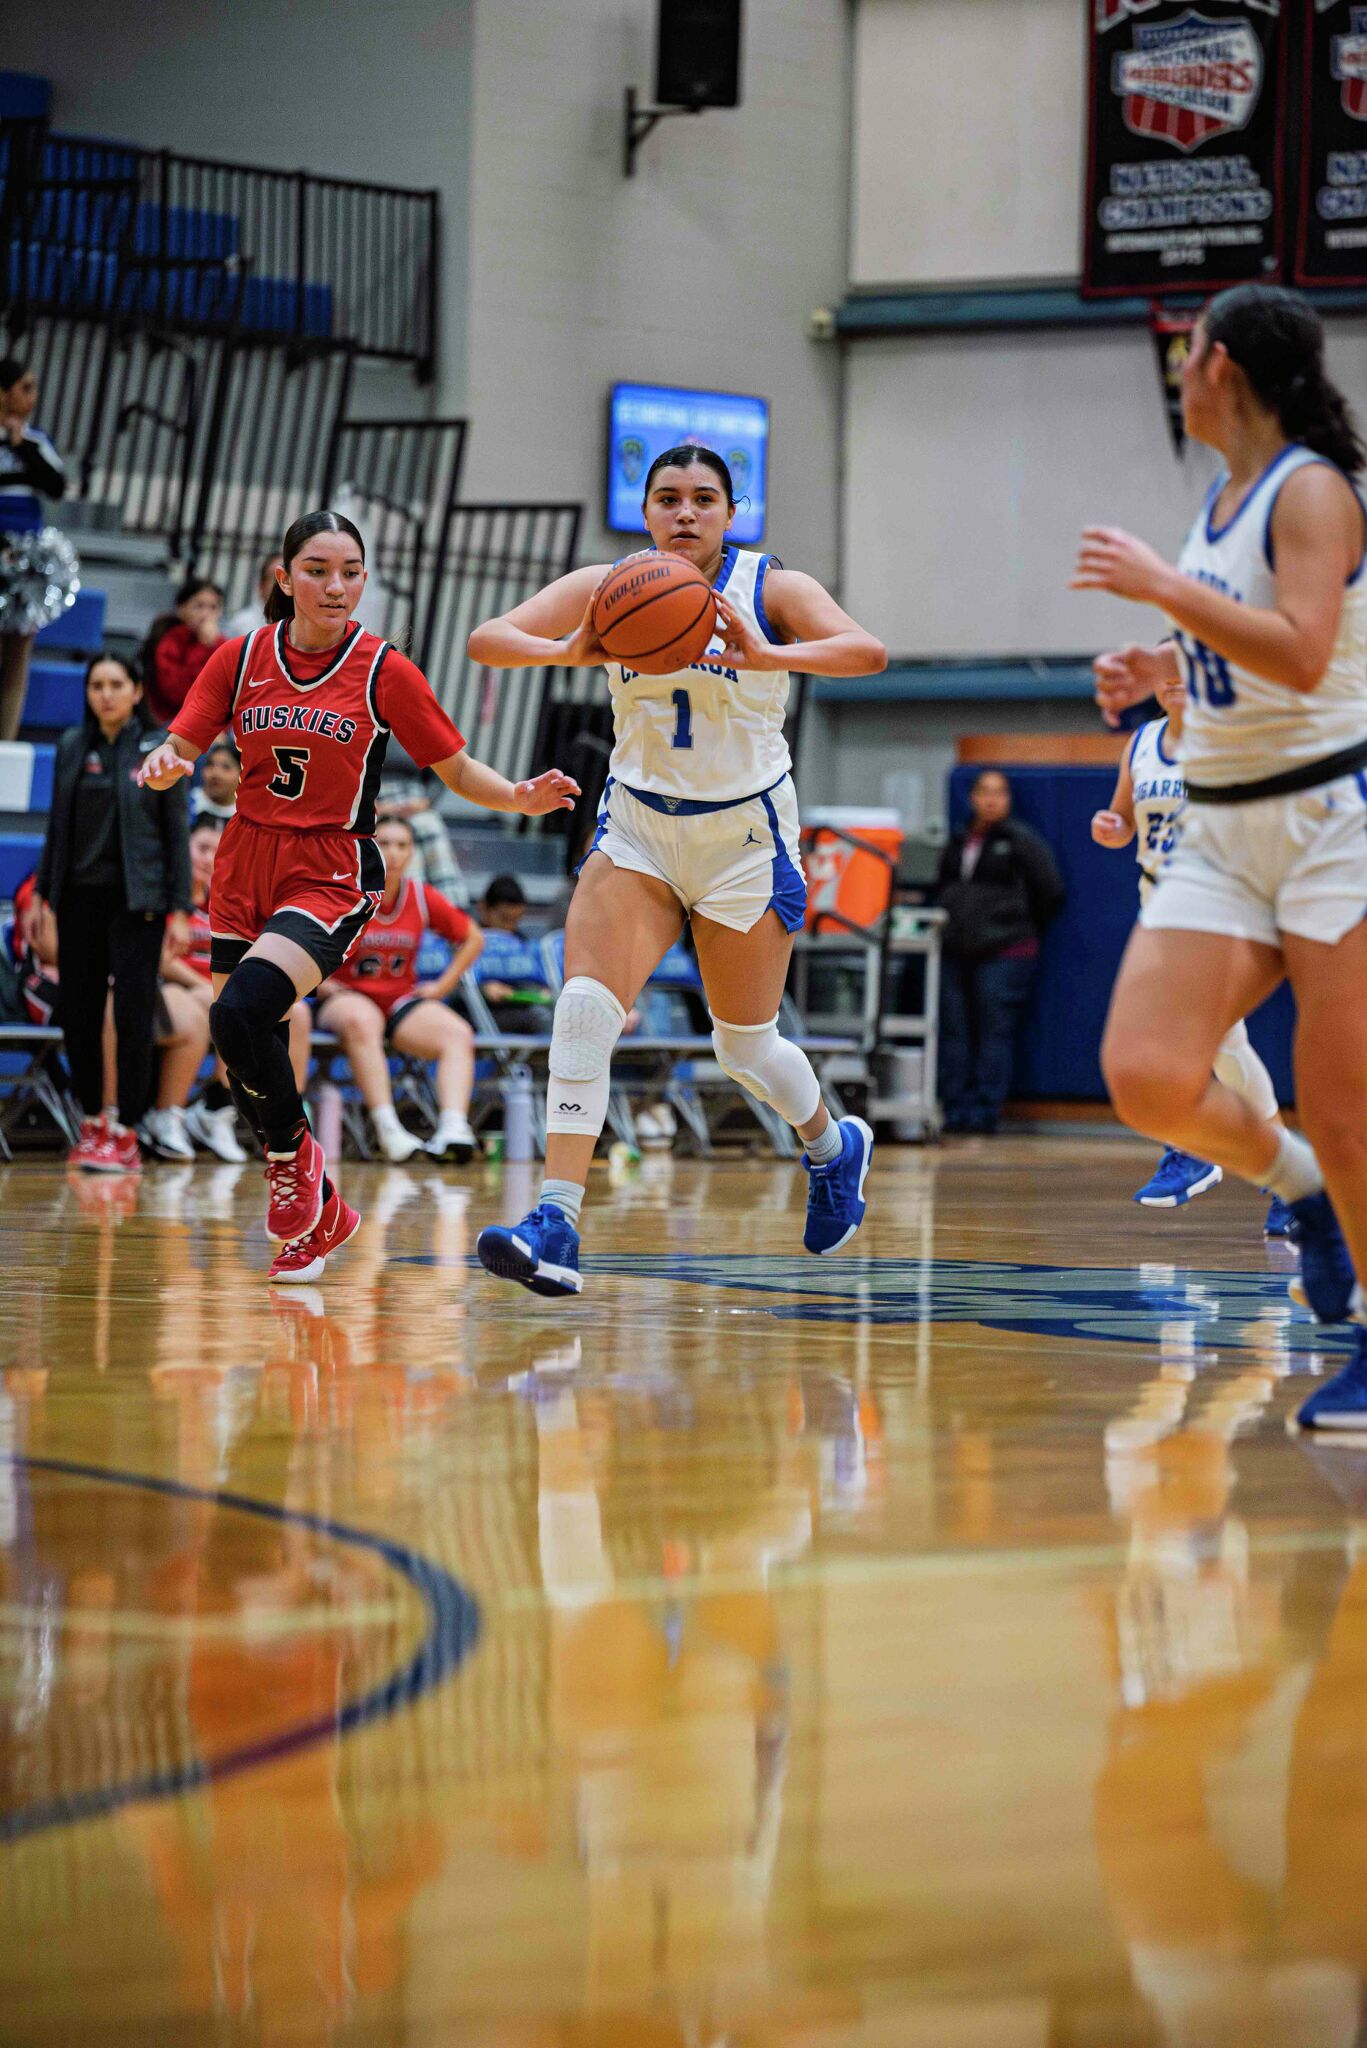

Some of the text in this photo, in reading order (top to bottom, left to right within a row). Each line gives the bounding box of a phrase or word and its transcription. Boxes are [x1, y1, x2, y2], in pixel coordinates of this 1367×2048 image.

[241, 706, 357, 744] HUSKIES
[671, 689, 694, 750] 1
[266, 746, 310, 800] 5
